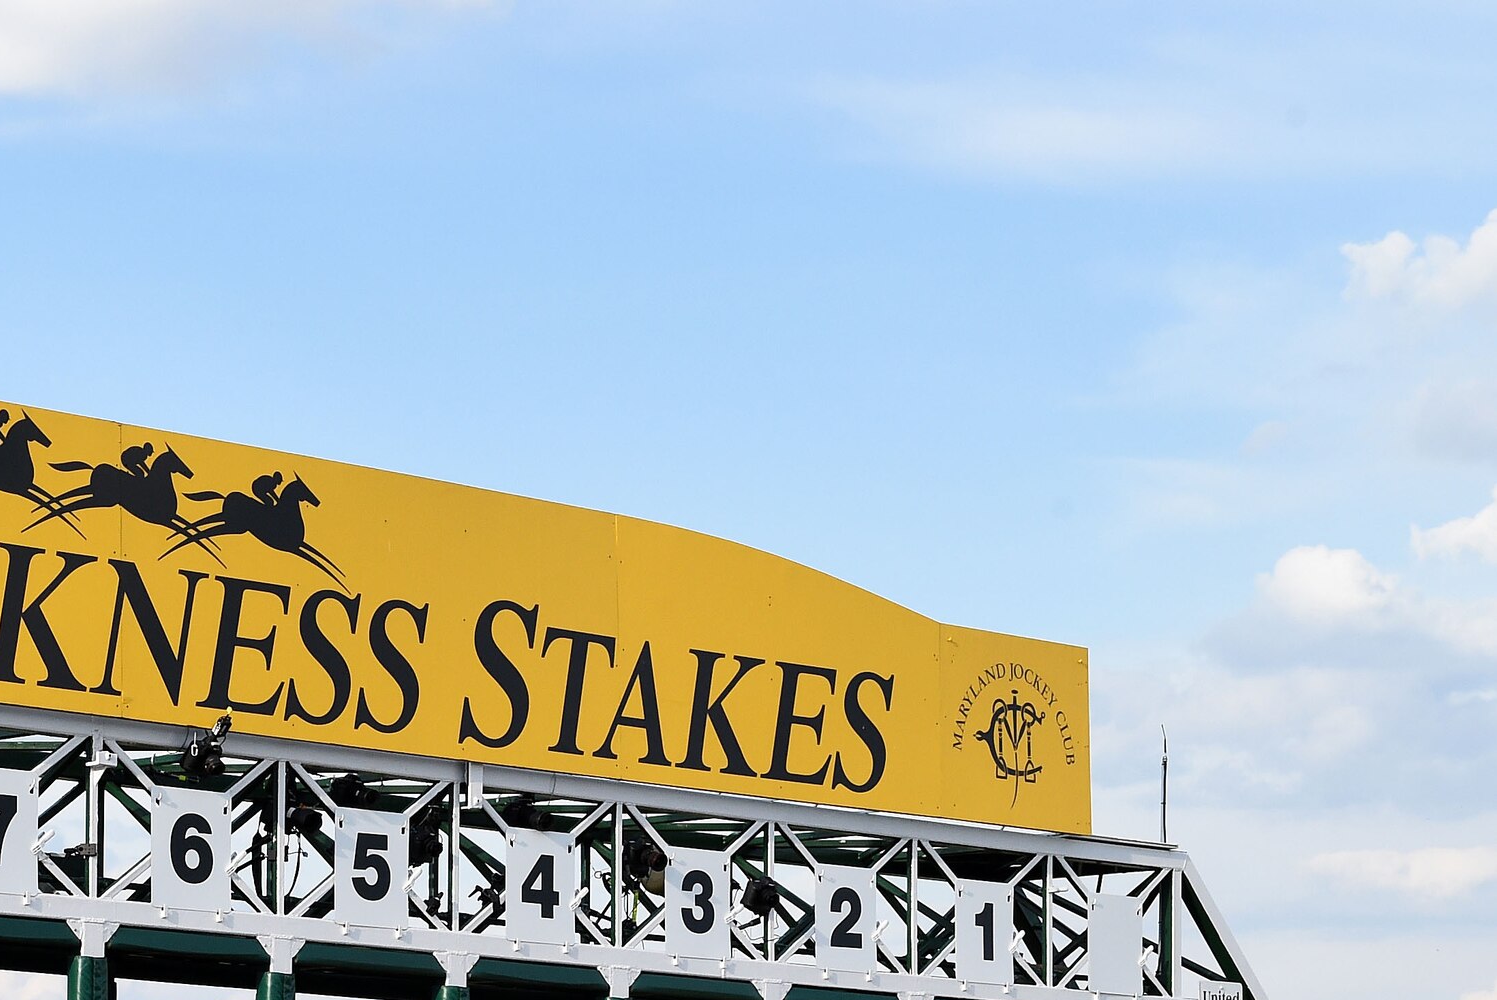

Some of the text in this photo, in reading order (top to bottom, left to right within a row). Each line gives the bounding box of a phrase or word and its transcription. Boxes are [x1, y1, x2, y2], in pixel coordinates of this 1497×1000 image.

[457, 599, 895, 793] STAKES
[952, 662, 1076, 766] MARYLAND JOCKEY CLUB
[170, 813, 214, 885] 6
[351, 832, 391, 902] 5
[521, 854, 560, 919] 4
[680, 869, 715, 934] 3
[830, 886, 863, 949] 2
[974, 902, 994, 962] 1
